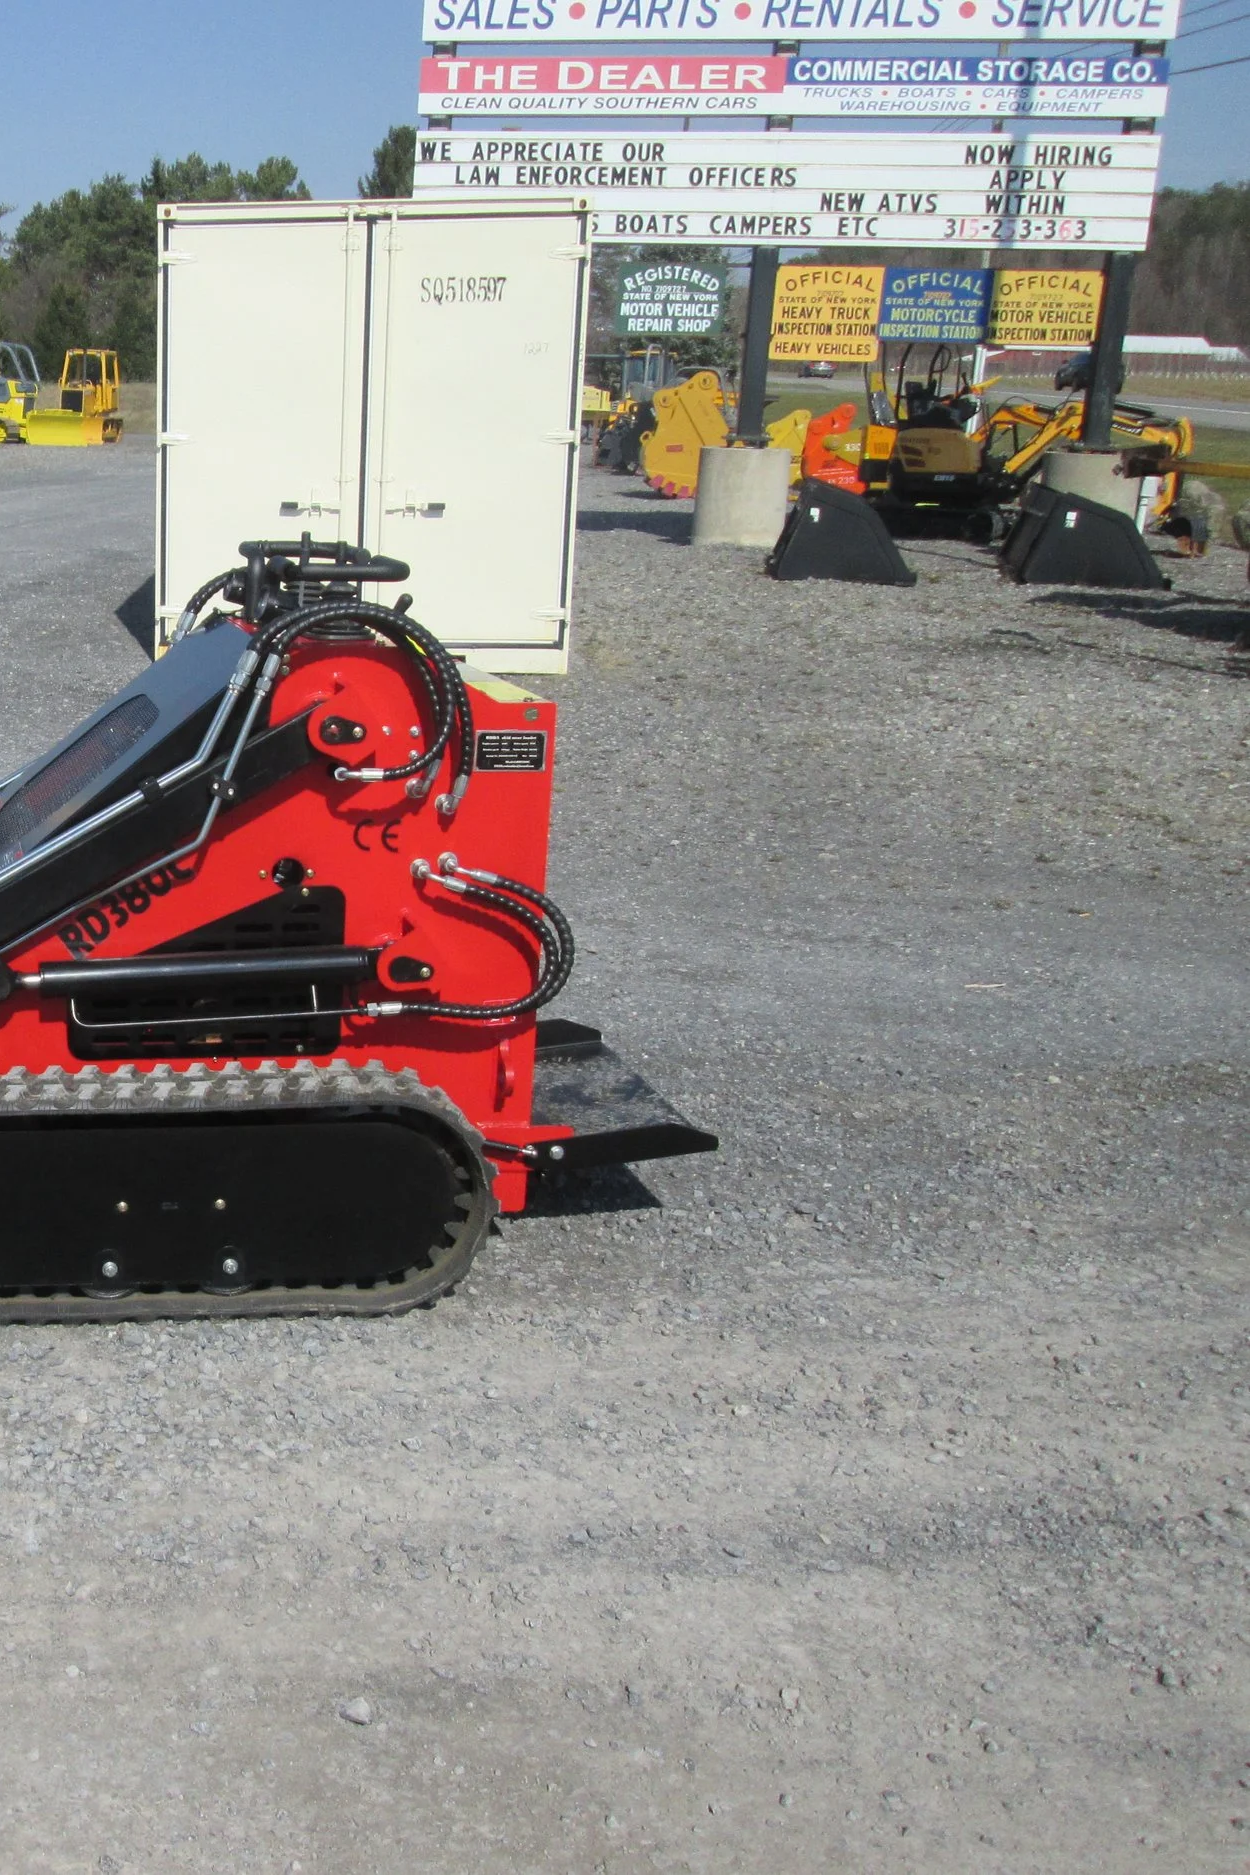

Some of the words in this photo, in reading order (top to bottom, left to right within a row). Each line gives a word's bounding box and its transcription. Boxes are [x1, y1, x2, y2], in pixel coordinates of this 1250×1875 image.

[434, 0, 554, 31] SALES
[596, 0, 719, 30] PARTS
[762, 0, 941, 29] RENTALS
[991, 0, 1165, 28] SERVICE
[437, 61, 538, 91] THE
[557, 60, 768, 91] DEALER
[793, 60, 969, 82] COMMERCIAL
[976, 60, 1105, 82] STORAGE
[1111, 61, 1158, 83] CO.
[802, 87, 873, 98] TRUCKS
[898, 87, 957, 99] BOATS
[982, 88, 1030, 99] CARS
[1056, 88, 1143, 100] CAMPERS
[441, 97, 506, 110] CLEAN
[508, 97, 590, 110] QUALITY
[593, 97, 703, 110] SOUTHERN
[705, 97, 758, 110] CARS
[839, 101, 971, 112] WAREHOUSING
[996, 101, 1102, 113] EQUIPMENT
[420, 142, 452, 161] WE
[472, 142, 603, 162] APPRECIATE
[622, 142, 665, 162] OUR
[964, 145, 1015, 165] NOW
[1034, 146, 1112, 166] HIRING
[455, 165, 500, 186] LAW
[516, 166, 667, 187] ENFORCEMENT
[689, 167, 798, 187] OFFICERS
[989, 170, 1066, 190] APPLY
[820, 193, 865, 213] NEW
[878, 193, 937, 213] ATVS
[985, 195, 1066, 215] WITHIN
[615, 214, 689, 234] BOATS
[709, 215, 812, 235] CAMPERS
[838, 217, 878, 237] ETC
[623, 265, 720, 292] REGISTERED
[785, 270, 875, 293] OFFICIAL
[892, 272, 984, 295] OFFICIAL
[1000, 275, 1092, 297] OFFICIAL
[420, 276, 507, 305] SQ518597
[622, 292, 651, 300] STATE
[654, 293, 667, 301] OF
[669, 293, 690, 301] NEW
[778, 296, 807, 304] STATE
[810, 296, 822, 304] OF
[885, 297, 915, 305] STATE
[620, 302, 663, 316] MOTOR
[666, 303, 720, 317] VEHICLE
[781, 306, 823, 320] HEAVY
[830, 307, 871, 320] TRUCK
[890, 308, 977, 323] MOTORCYCLE
[990, 310, 1033, 323] MOTOR
[1039, 311, 1095, 324] VEHICLE
[627, 318, 673, 332] REPAIR
[676, 319, 711, 332] SHOP
[773, 322, 832, 336] INSPECTION
[835, 323, 878, 336] STATION
[879, 324, 940, 338] INSPECTION
[988, 328, 1047, 340] INSPECTION
[1049, 329, 1093, 341] STATION
[774, 342, 811, 354] HEAVY
[817, 343, 871, 355] VEHICLES
